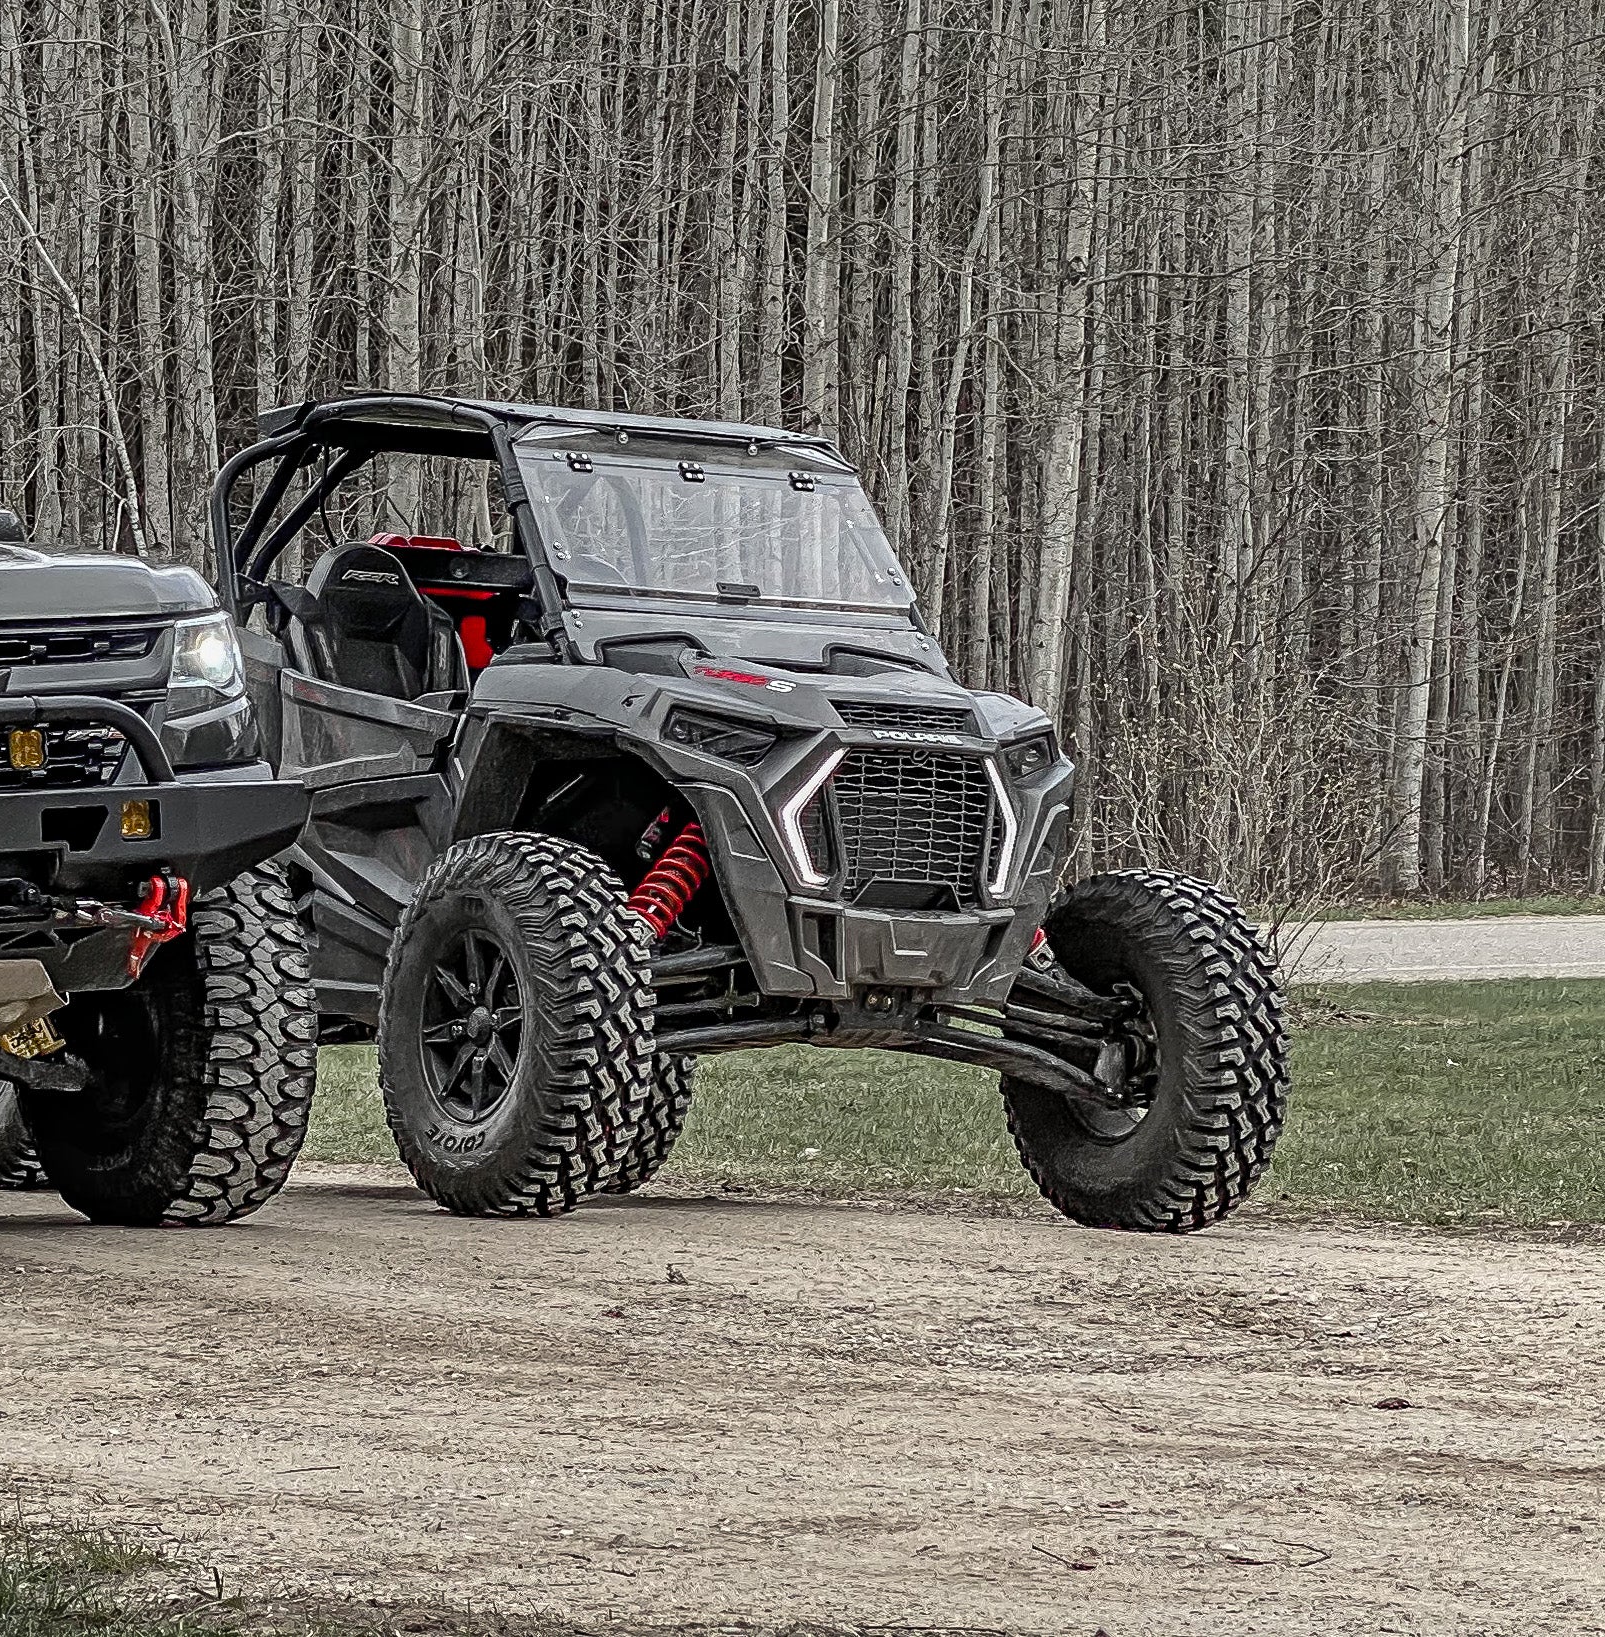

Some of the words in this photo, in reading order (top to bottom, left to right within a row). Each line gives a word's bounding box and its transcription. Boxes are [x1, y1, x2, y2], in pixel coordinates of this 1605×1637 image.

[342, 569, 399, 585] RZR
[765, 680, 797, 693] S
[872, 729, 964, 745] POLARIS
[424, 1121, 487, 1153] COYOTE
